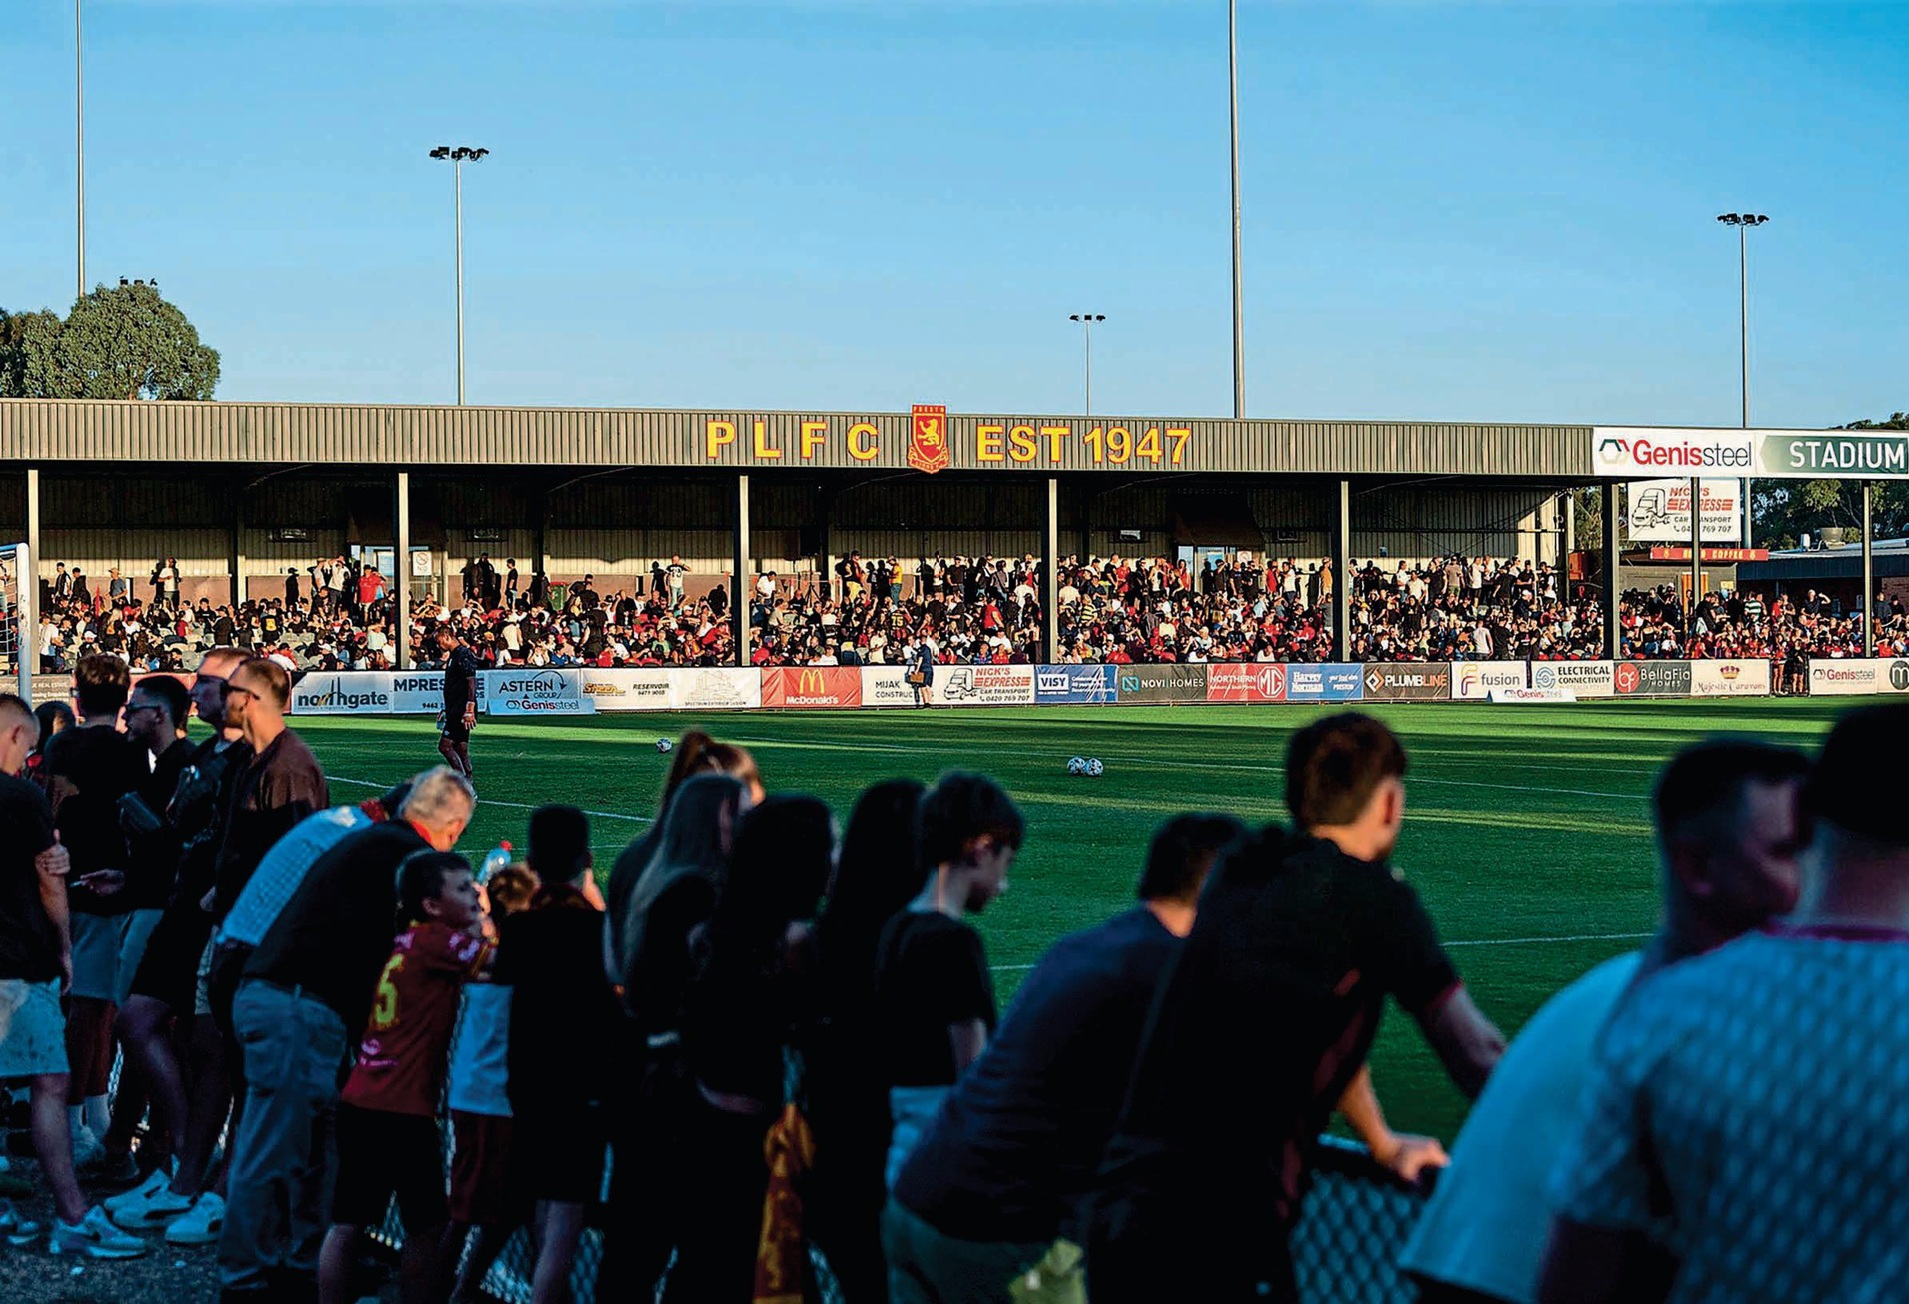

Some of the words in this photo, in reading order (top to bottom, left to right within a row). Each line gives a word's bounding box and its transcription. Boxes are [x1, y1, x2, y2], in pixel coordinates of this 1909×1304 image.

[976, 424, 1071, 463] EST
[1084, 426, 1193, 465] 1947
[1633, 439, 1752, 467] Genissteel
[1789, 441, 1905, 469] STADIUM
[1670, 487, 1710, 497] NIC'S
[1678, 499, 1722, 511] EXRESS
[1702, 525, 1716, 533] 769
[1718, 525, 1732, 533] 707
[975, 667, 1011, 676] NICK'S
[1558, 666, 1610, 676] ELECTRICAL
[1826, 668, 1876, 680] Genissteel
[983, 677, 1021, 687] EXPRESS
[1041, 677, 1066, 687] VISY
[1141, 678, 1165, 688] NOVI
[1170, 677, 1205, 687] HOMES
[1210, 675, 1256, 683] NORTHERN
[1385, 674, 1448, 687] PLUMBLINE
[1481, 672, 1520, 686] fusion
[1558, 676, 1610, 684] CONNECTIVITY
[499, 679, 553, 694] ASTERN
[875, 680, 900, 689] MIJAK
[298, 676, 388, 709] northgate
[1516, 689, 1563, 699] Genisteel
[521, 699, 580, 710] Genissteel
[786, 695, 840, 705] McDonald's
